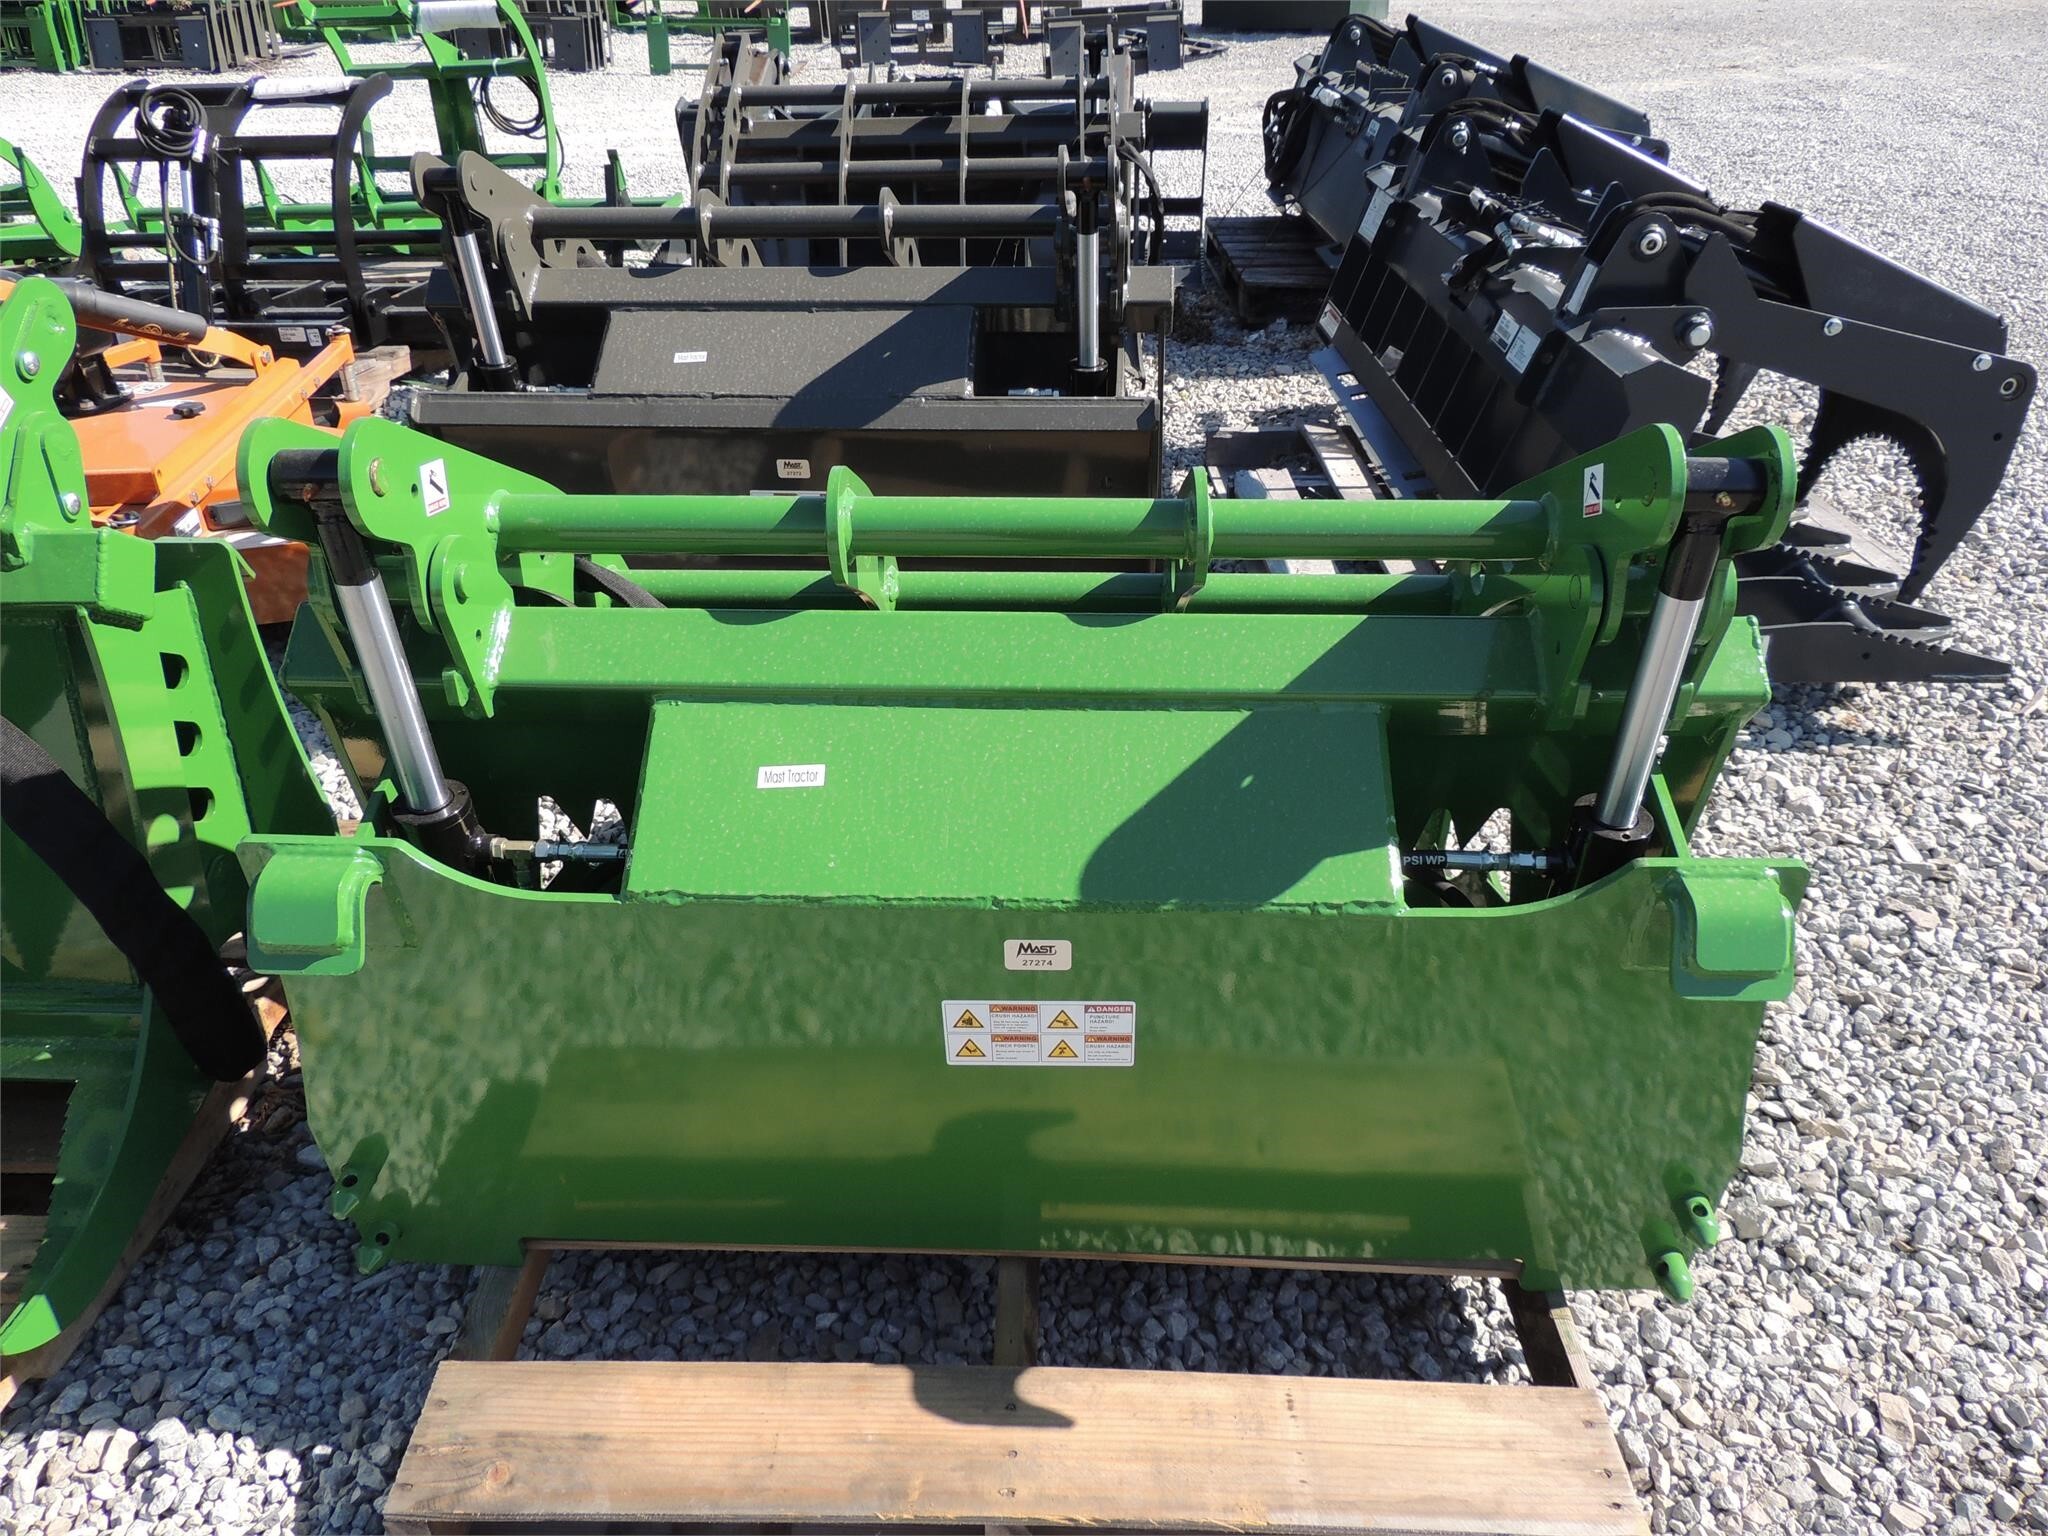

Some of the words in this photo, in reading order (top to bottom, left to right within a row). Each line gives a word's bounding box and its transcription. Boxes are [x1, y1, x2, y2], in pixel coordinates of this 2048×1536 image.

[764, 770, 786, 783] Mast
[788, 769, 819, 783] Tractor
[1403, 856, 1423, 866] PSI
[1425, 855, 1446, 865] WP
[1016, 942, 1057, 958] MAST
